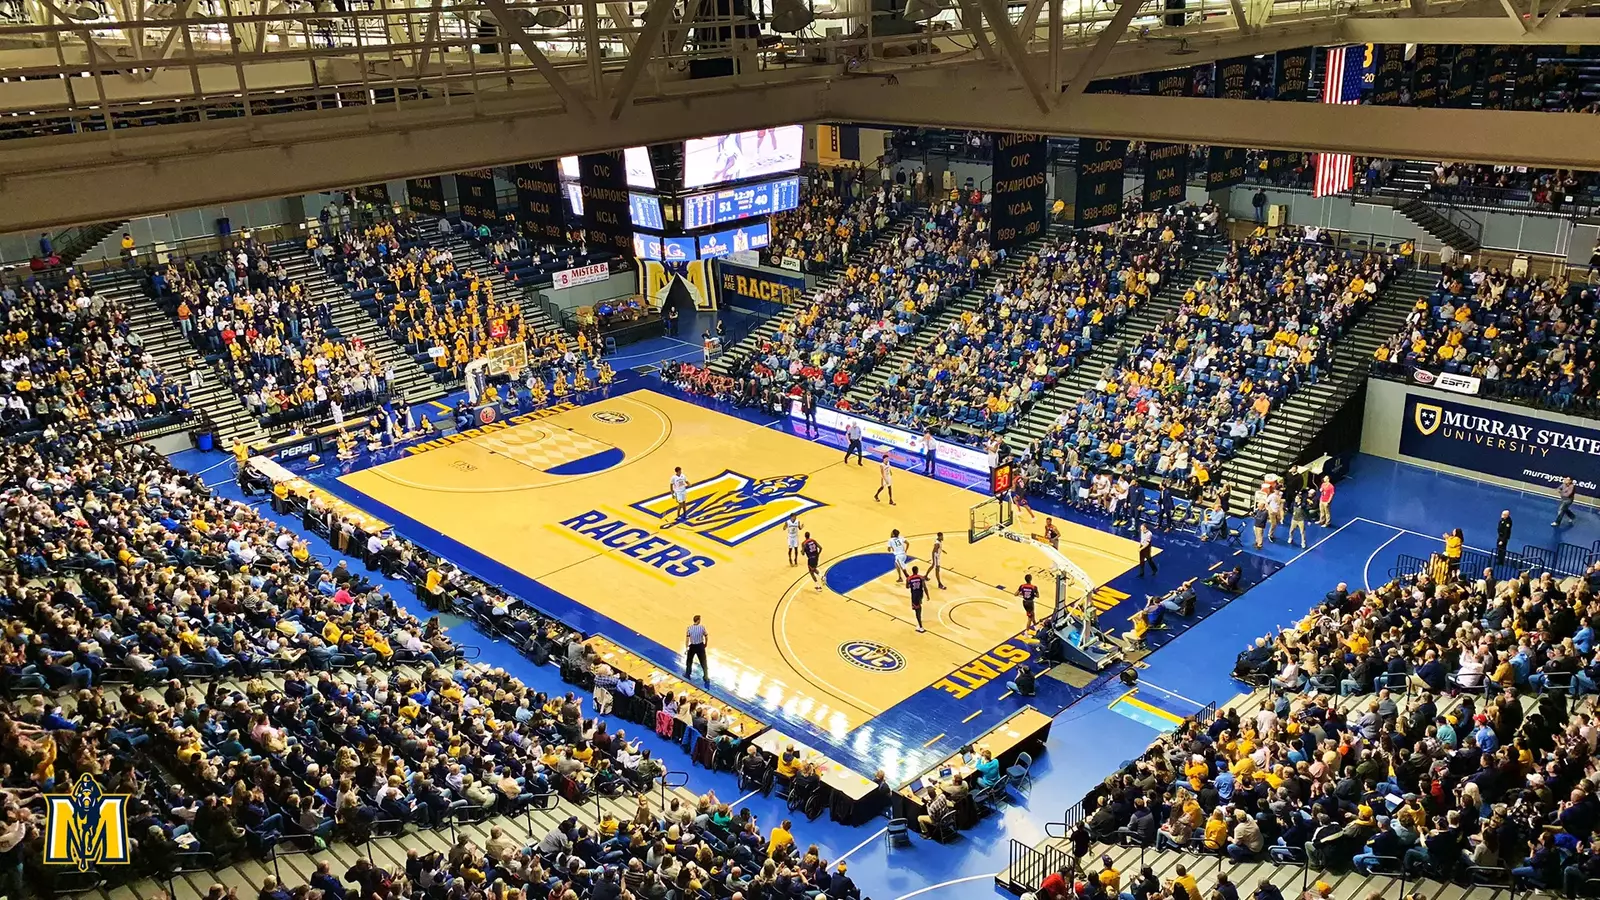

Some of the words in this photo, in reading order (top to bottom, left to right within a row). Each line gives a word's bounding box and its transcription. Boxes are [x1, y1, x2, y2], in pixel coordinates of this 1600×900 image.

[1158, 76, 1187, 92] MURRAY
[1225, 76, 1245, 90] STATE
[1010, 153, 1031, 168] OVC
[593, 164, 611, 178] OVC
[996, 172, 1045, 194] CHAMPIONS
[719, 201, 732, 213] 51
[755, 194, 768, 205] 40
[571, 265, 600, 278] MISTER
[723, 273, 734, 283] WE
[723, 281, 736, 291] ARE
[404, 419, 511, 456] MURRAY
[509, 401, 581, 425] STATE
[1442, 410, 1533, 441] MURRAY
[1536, 429, 1600, 455] STATE
[280, 442, 313, 459] PEPSI
[1442, 427, 1549, 457] UNIVERSITY
[995, 474, 1009, 491] 30
[1523, 469, 1597, 490] murrayste.edu
[558, 509, 716, 577] RACERS
[848, 645, 894, 667] OVC
[931, 644, 1031, 700] STATE
